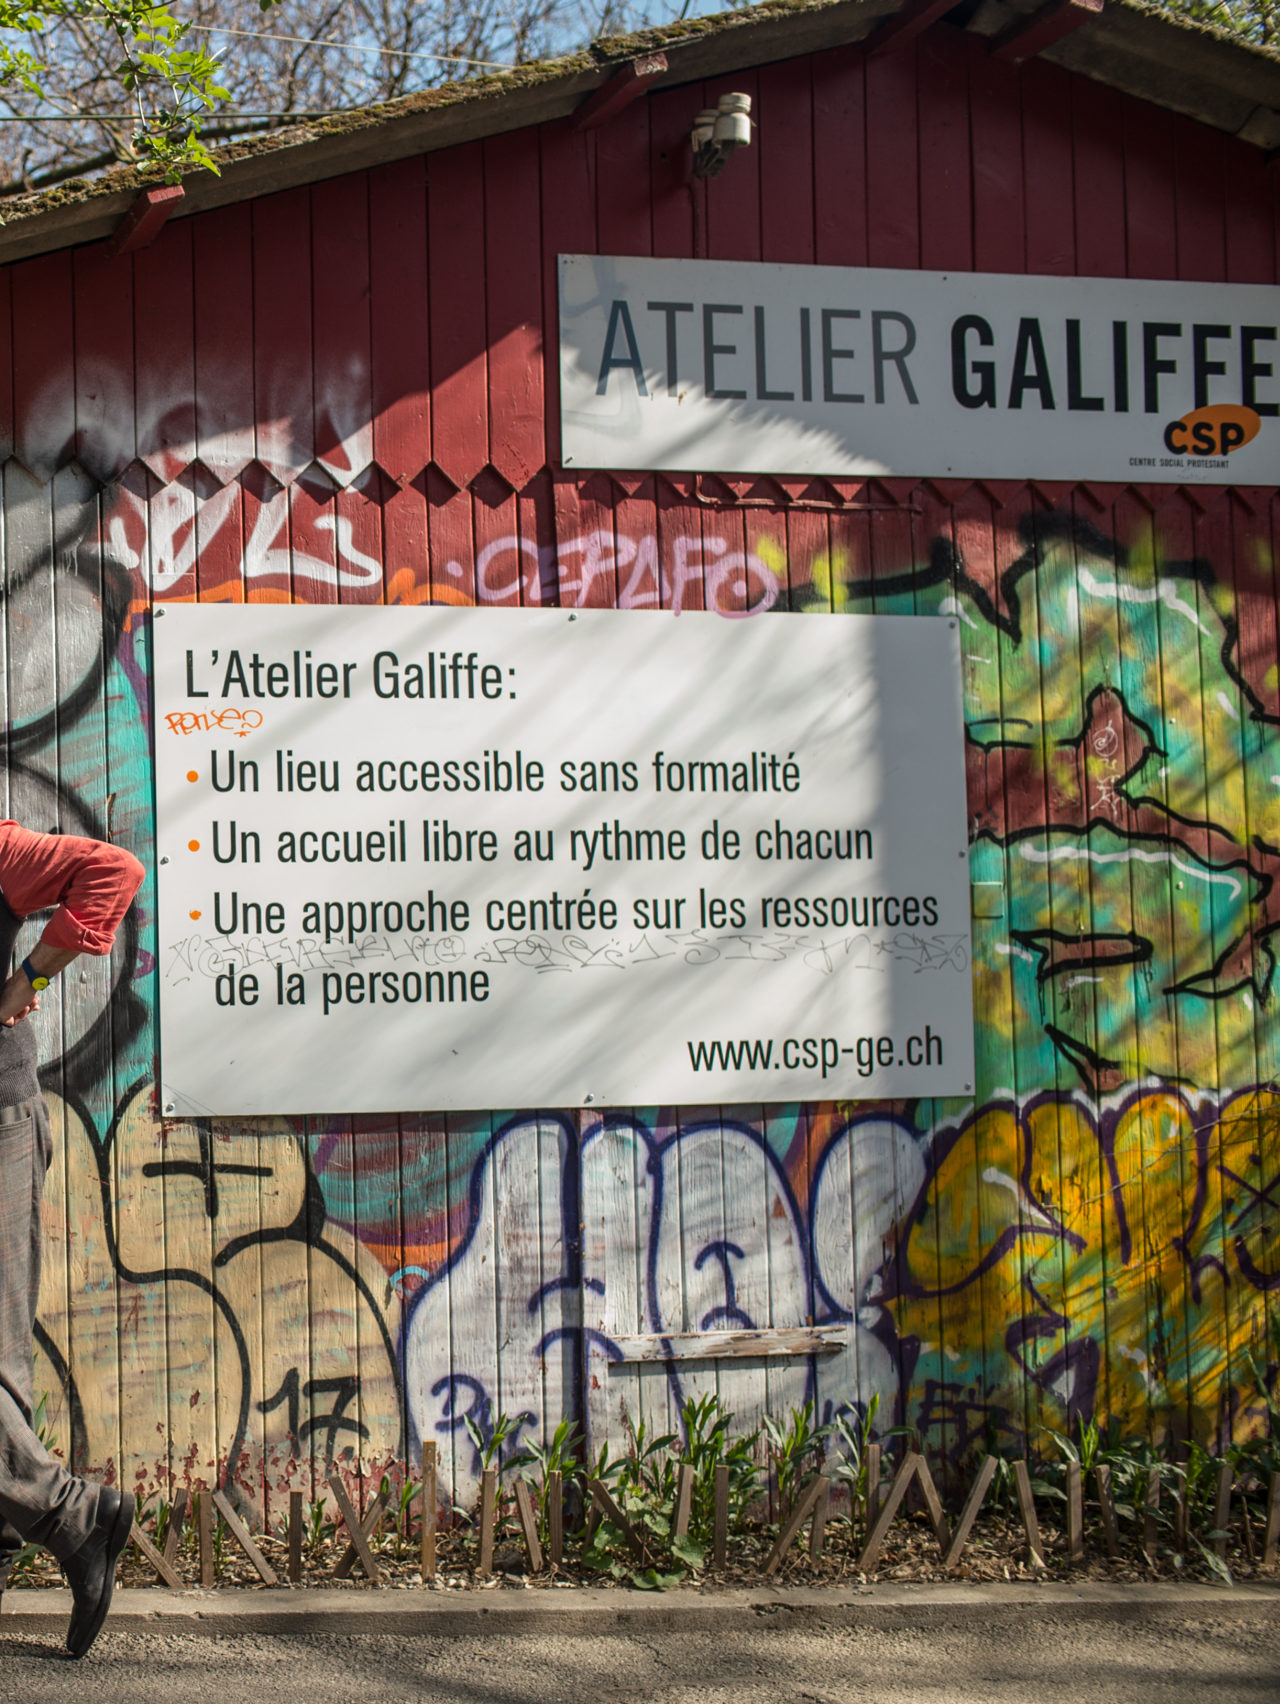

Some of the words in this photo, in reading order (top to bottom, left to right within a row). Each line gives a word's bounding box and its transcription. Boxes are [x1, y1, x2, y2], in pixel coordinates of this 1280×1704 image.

[595, 299, 920, 405] ATELIER
[950, 314, 1280, 418] GALIFFE
[1129, 457, 1157, 467] CENTRE
[1160, 458, 1184, 467] SOCIAL
[1187, 459, 1229, 469] PROTESTANT
[1163, 420, 1245, 456] CSP
[186, 650, 357, 699] L'Atelier
[373, 651, 517, 700] Galiffe:
[211, 750, 259, 793] Un
[276, 750, 339, 793] lieu
[356, 750, 544, 793] accessible
[560, 760, 639, 793] sans
[652, 751, 801, 793] formalité
[212, 821, 260, 864] Un
[278, 820, 406, 864] accueil
[423, 820, 498, 863] libre
[514, 829, 555, 863] au
[570, 820, 686, 872] rythme
[701, 819, 740, 861] de
[756, 819, 873, 861] chacun
[214, 892, 286, 935] Une
[302, 890, 470, 944] approche
[486, 888, 618, 931] centrée
[633, 897, 687, 931] sur
[700, 888, 747, 930] les
[761, 893, 940, 929] ressources
[215, 962, 260, 1007] de
[276, 962, 306, 1006] la
[322, 970, 490, 1015] personne
[687, 1024, 944, 1079] www.csp-ge.ch
